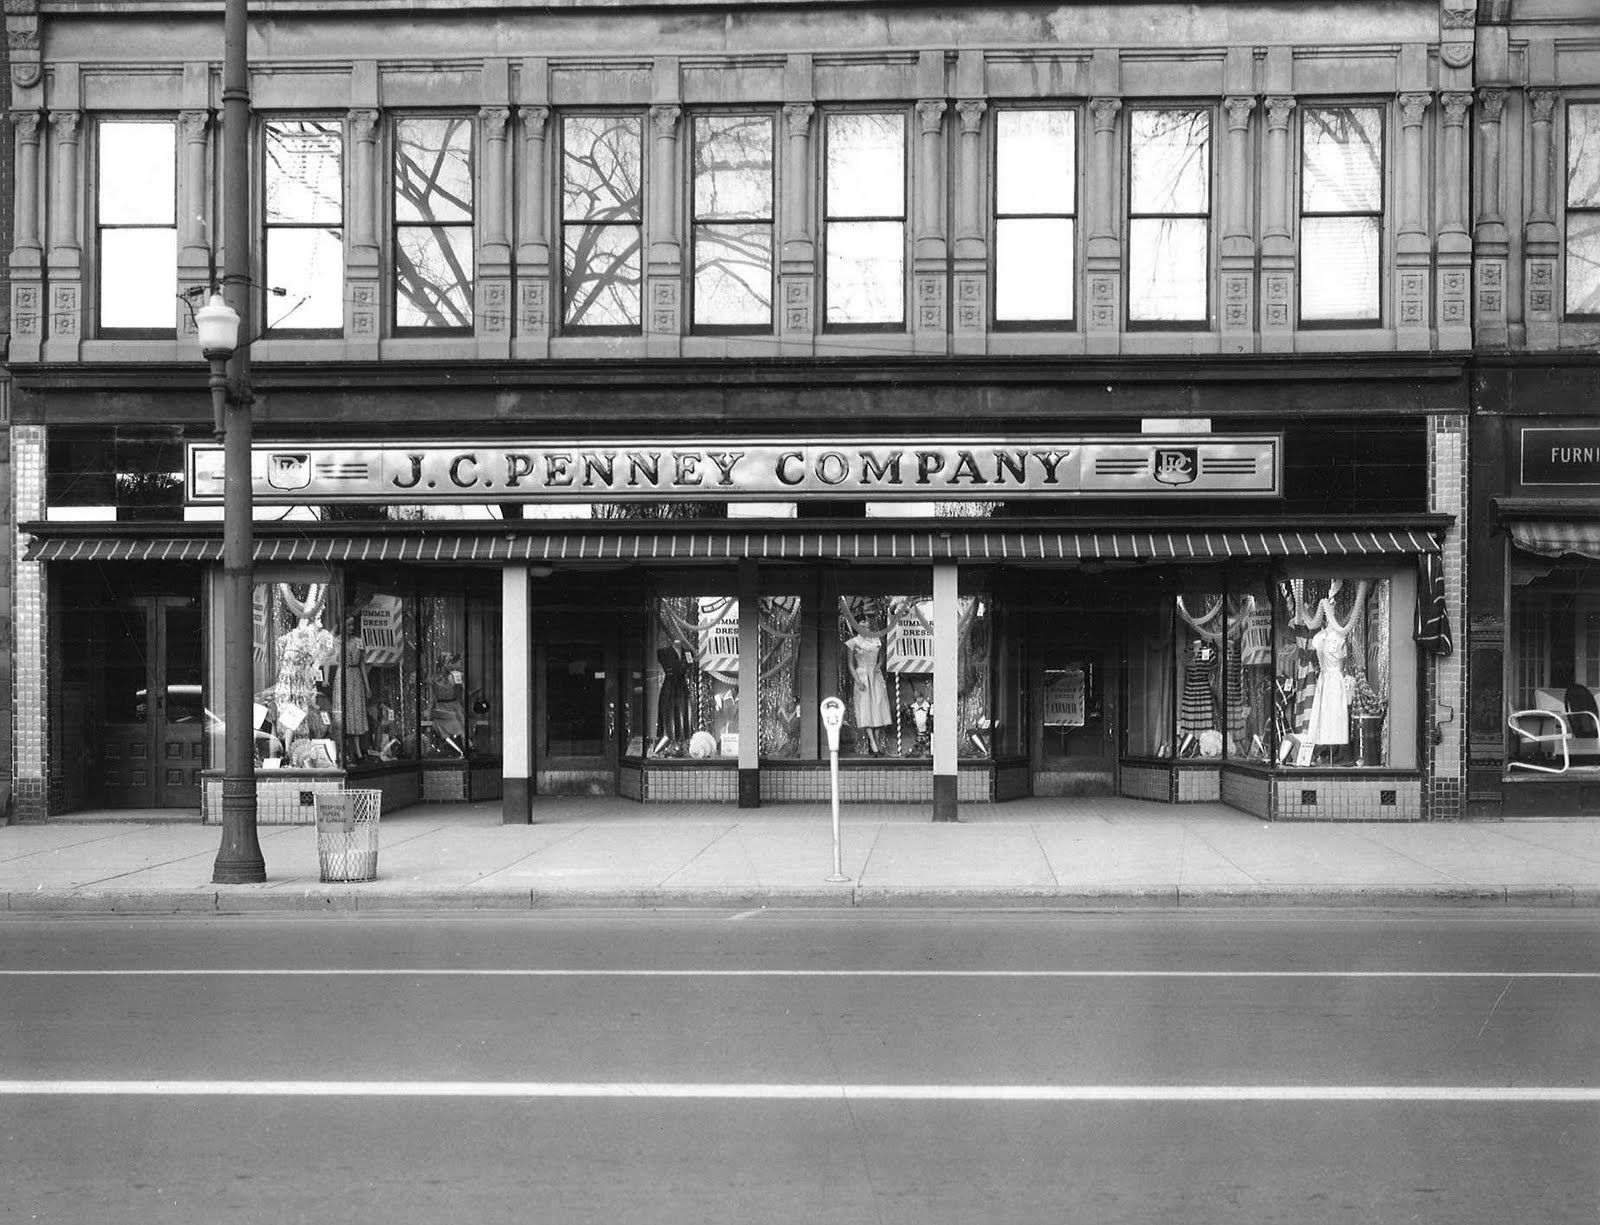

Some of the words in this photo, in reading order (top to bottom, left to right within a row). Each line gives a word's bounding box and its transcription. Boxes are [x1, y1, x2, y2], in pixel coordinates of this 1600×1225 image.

[1551, 447, 1600, 463] FURNI
[504, 452, 745, 486] PENNEY
[774, 450, 1070, 485] COMPANY
[715, 627, 739, 635] DRES
